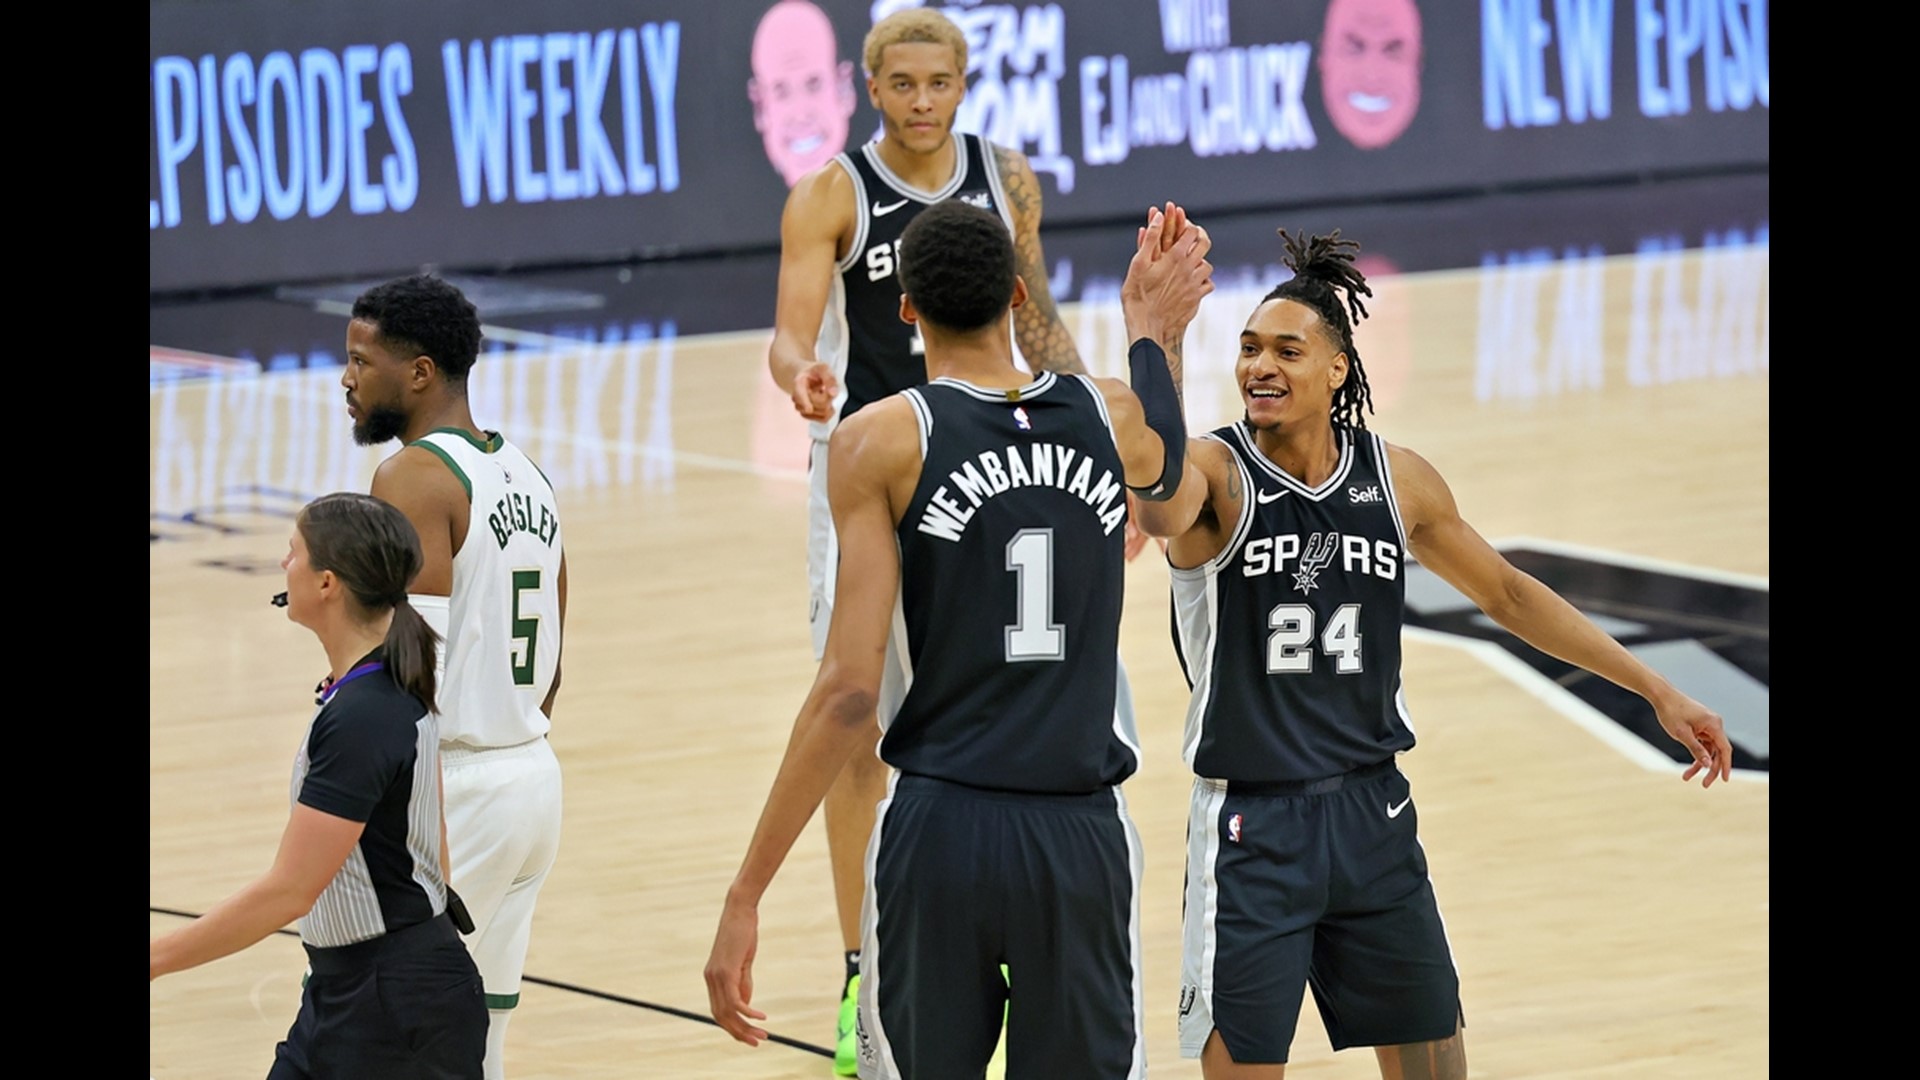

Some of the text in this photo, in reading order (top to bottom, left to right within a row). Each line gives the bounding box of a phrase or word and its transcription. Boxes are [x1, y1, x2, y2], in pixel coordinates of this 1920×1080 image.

[150, 20, 681, 229] PISODES WEEKLY
[1079, 54, 1129, 166] EJ
[1186, 40, 1317, 157] CHUCK
[1480, 0, 1614, 130] NEW
[488, 492, 558, 551] BEASLEY
[917, 442, 1128, 543] WEMBANYAMA
[1348, 485, 1383, 504] Self.
[510, 566, 543, 689] 5
[1004, 527, 1066, 663] 1
[1266, 603, 1364, 674] 24
